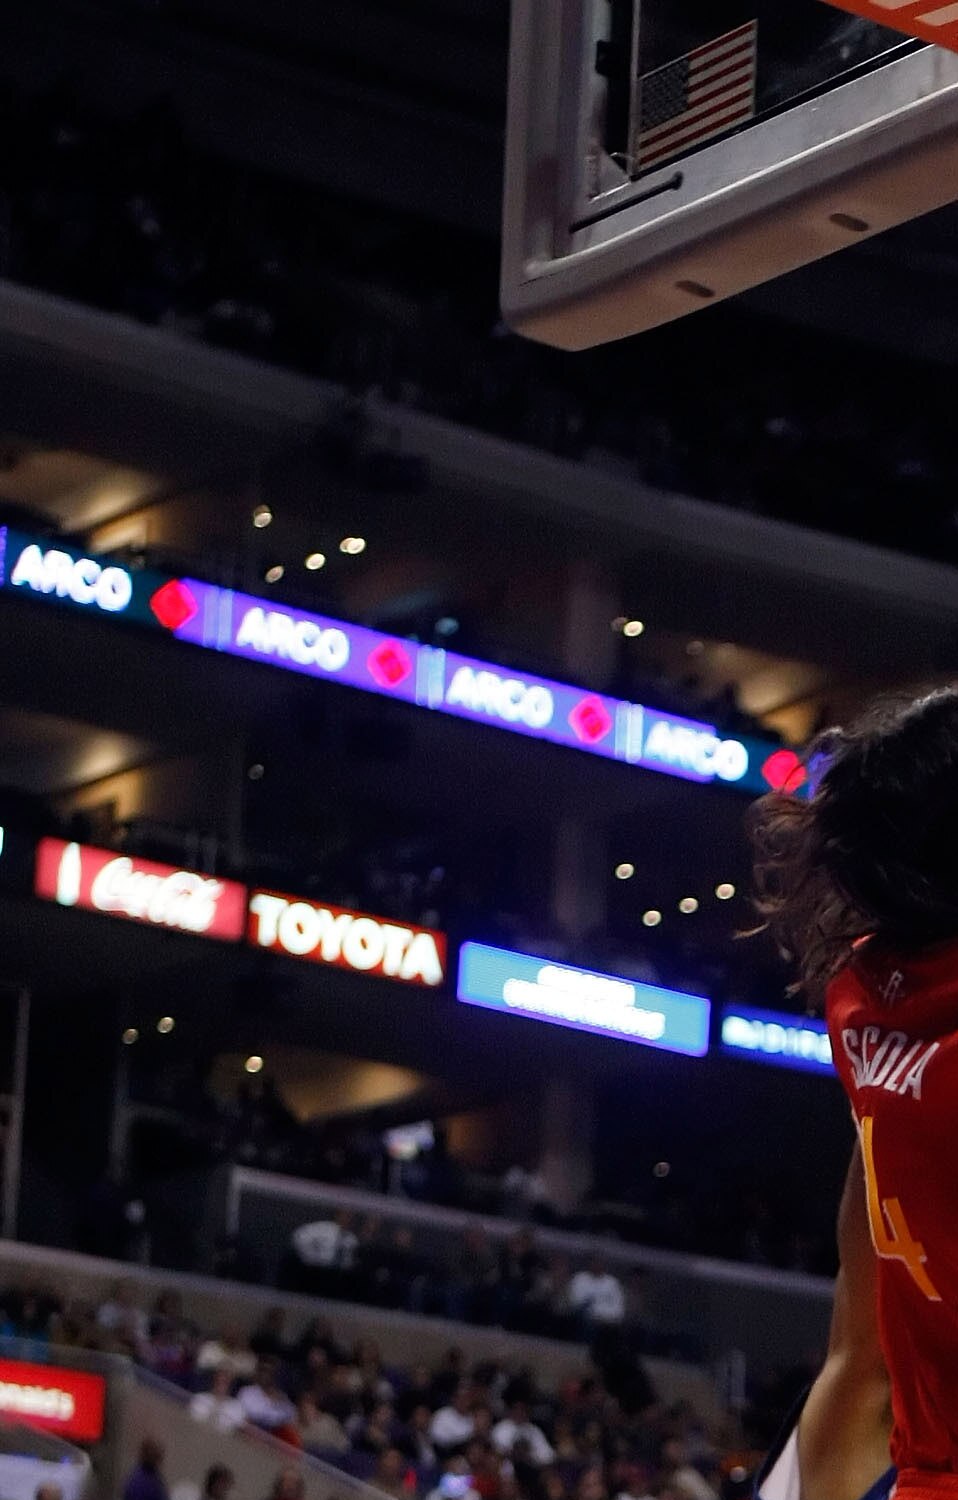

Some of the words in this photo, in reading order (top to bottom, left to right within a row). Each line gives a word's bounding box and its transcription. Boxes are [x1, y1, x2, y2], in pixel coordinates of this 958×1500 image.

[12, 544, 132, 611] ARCO
[236, 607, 350, 672] ARCO
[446, 666, 554, 728] ARCO
[644, 721, 749, 782] ARCO
[250, 893, 443, 986] TOYOTA
[841, 1025, 941, 1100] SCOLA
[852, 1107, 943, 1301] 4
